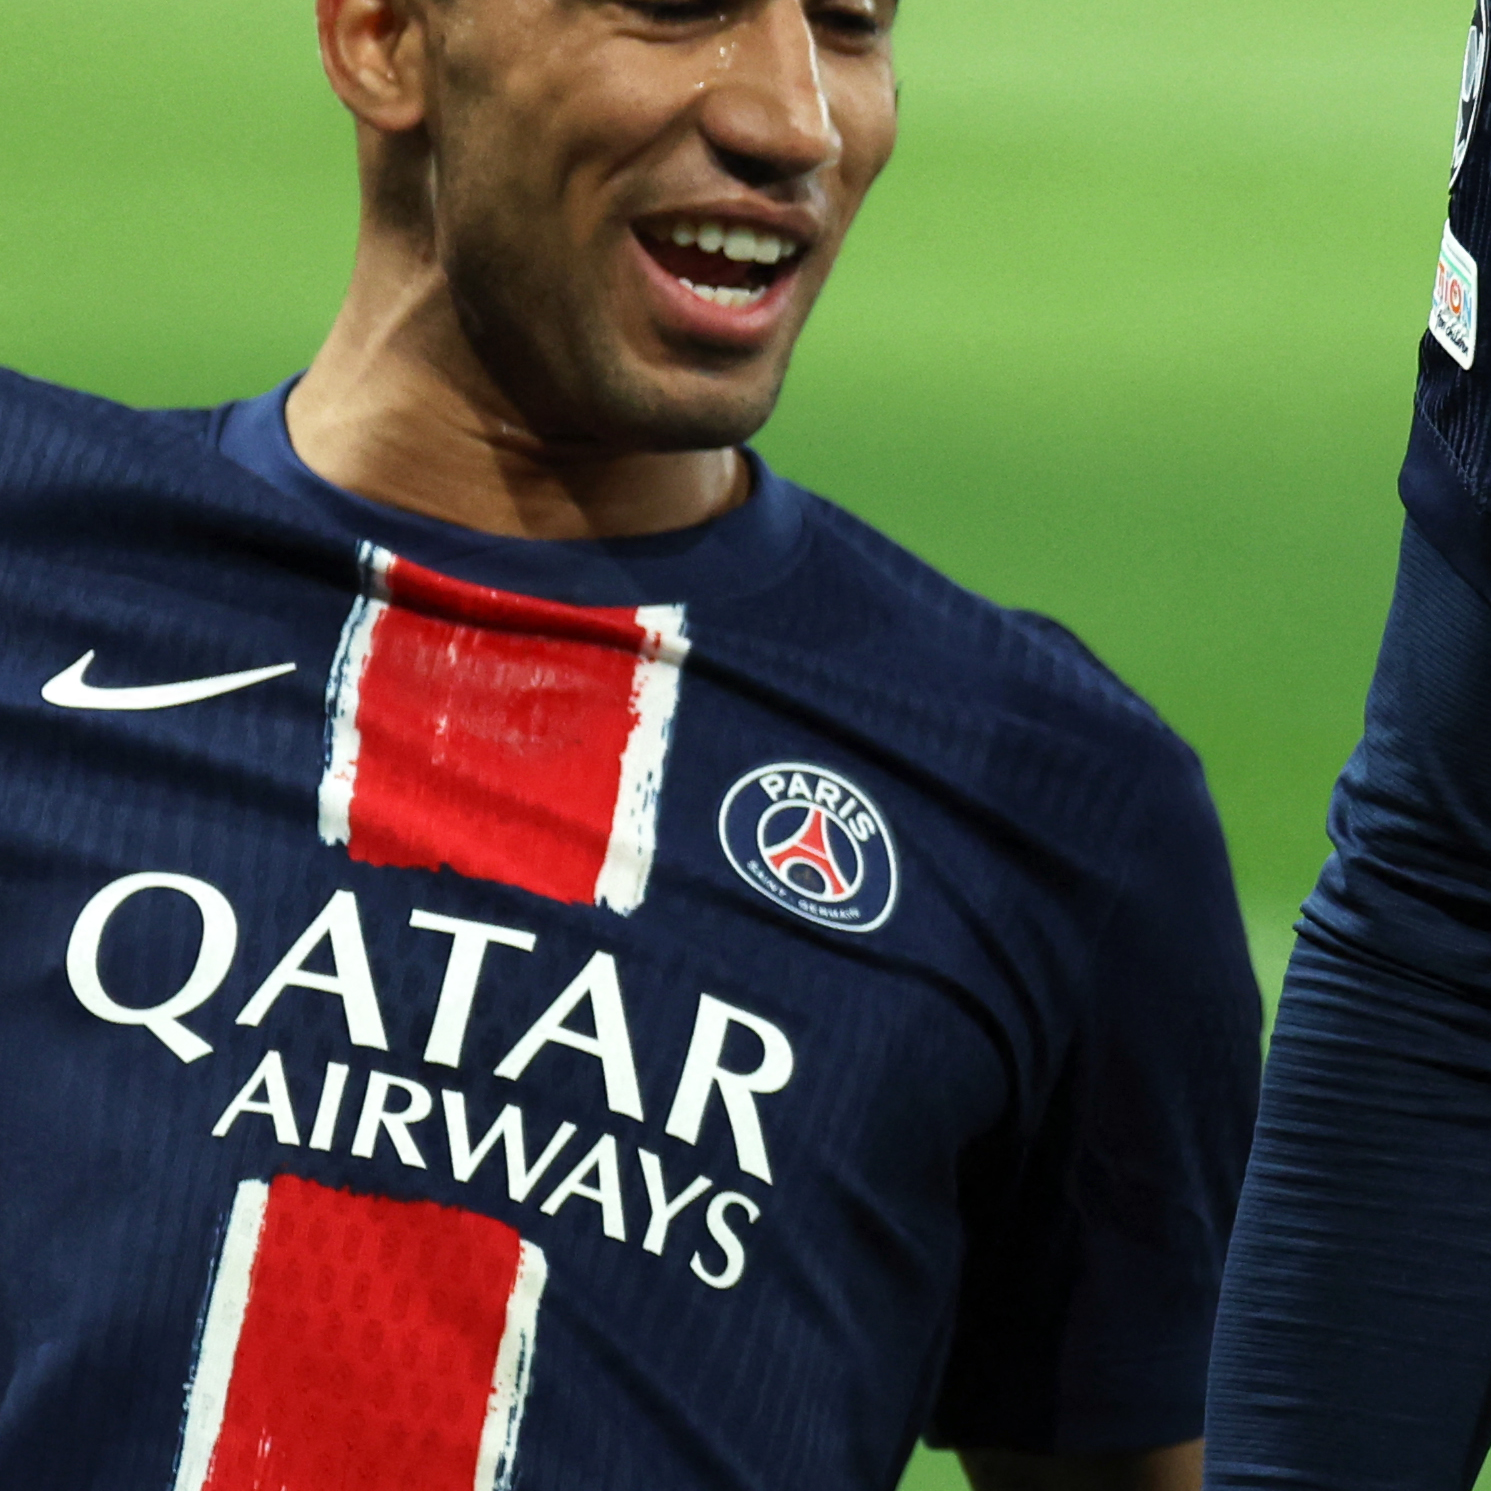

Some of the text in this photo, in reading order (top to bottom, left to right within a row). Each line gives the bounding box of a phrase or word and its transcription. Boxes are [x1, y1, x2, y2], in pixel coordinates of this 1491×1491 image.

[758, 771, 878, 843] PARIS
[66, 871, 795, 1186] QATAR
[211, 1049, 761, 1290] AIRWAYS
